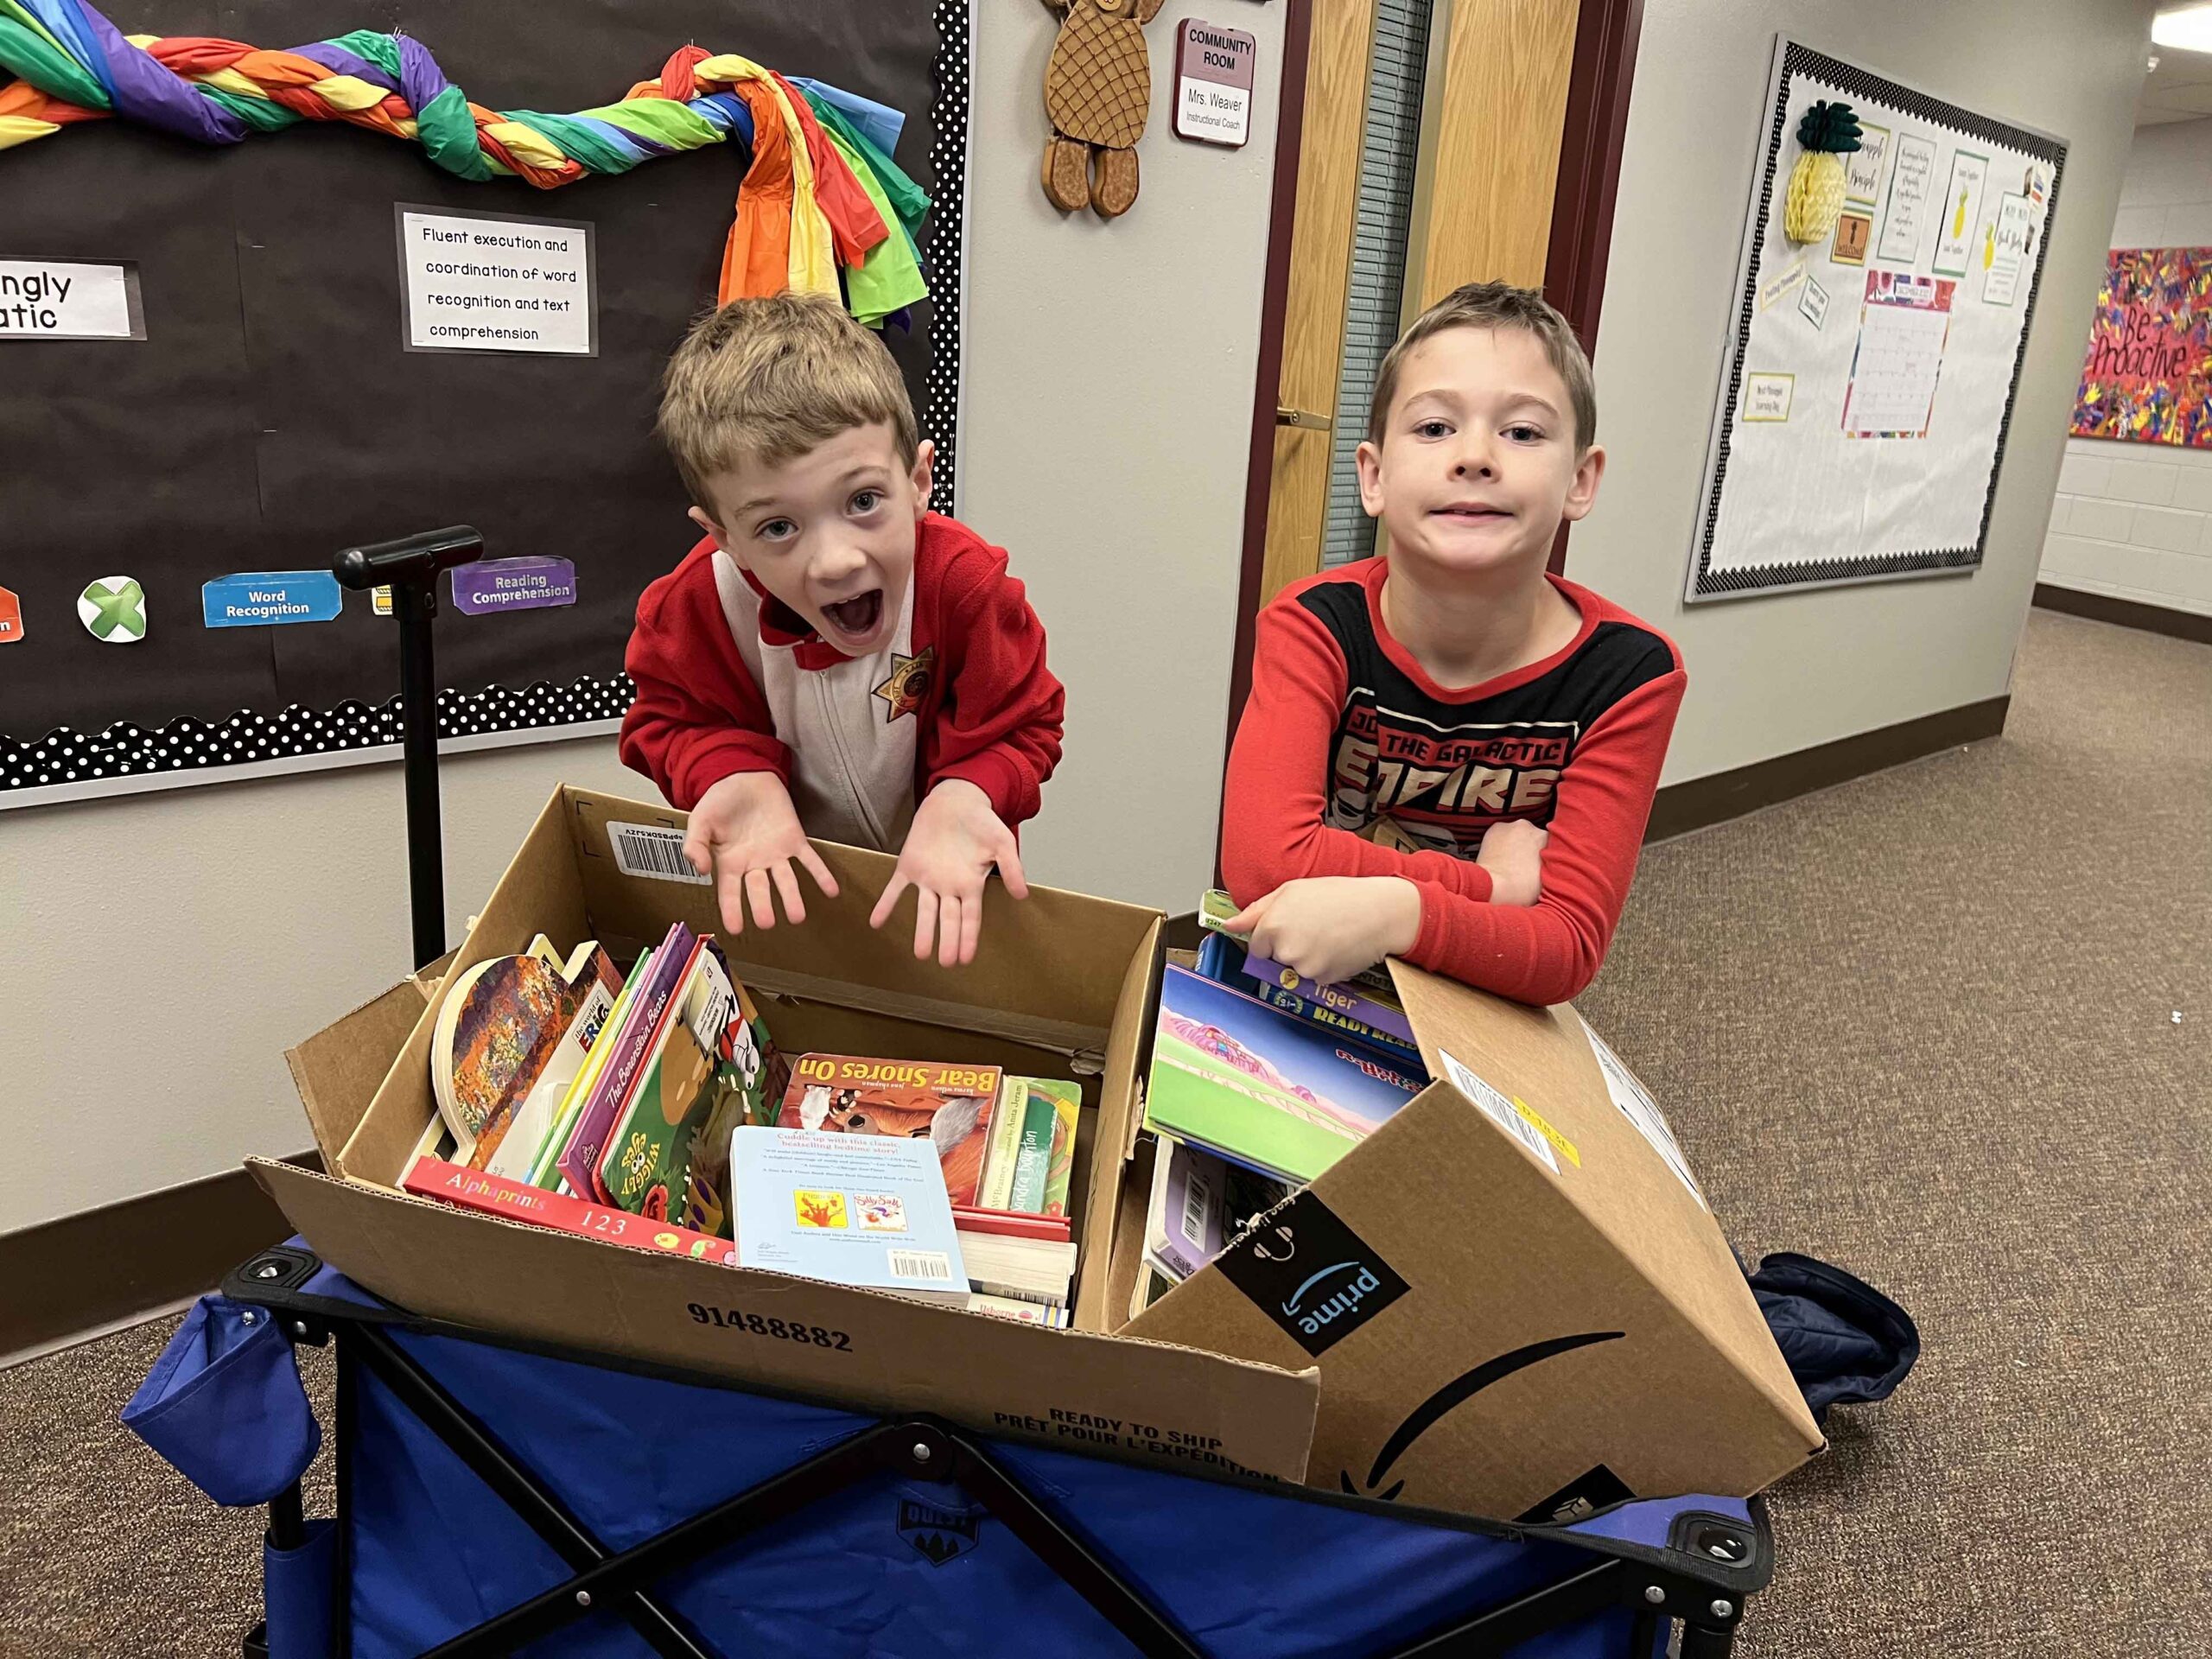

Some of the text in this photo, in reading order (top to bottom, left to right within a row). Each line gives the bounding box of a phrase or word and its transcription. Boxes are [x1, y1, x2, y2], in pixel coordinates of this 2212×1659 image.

[1190, 29, 1252, 54] COMMUNITY
[1204, 52, 1236, 69] ROOM
[1188, 88, 1243, 111] Mrs. Weaver
[1186, 111, 1240, 130] Instructional Coach
[423, 228, 568, 252] Fluent execution and
[426, 262, 576, 283] coordination of word
[2, 271, 71, 303] ngly
[428, 294, 570, 311] recognition and text
[429, 325, 538, 340] comprehension
[2124, 306, 2151, 346] Be
[2093, 333, 2187, 379] Proactive
[472, 586, 570, 604] Comprehension
[496, 575, 547, 589] Reading
[249, 590, 286, 602] Word
[226, 603, 309, 618] Recognition
[1385, 734, 1562, 763] THE GALACTIC
[1315, 983, 1357, 1010] Tiger
[575, 995, 601, 1039] the world of
[1313, 1006, 1370, 1035] READY
[605, 1084, 623, 1109] The
[647, 990, 667, 1027] Bears
[799, 1058, 996, 1092] Bear Snores On
[1008, 1107, 1018, 1131] Anita
[778, 1133, 810, 1141] Cuddle
[827, 1135, 848, 1144] with
[621, 1142, 660, 1195] WIGGLY
[446, 1172, 547, 1211] Alphaprints
[1298, 1266, 1380, 1334] prime
[687, 1302, 854, 1353] 91488882
[995, 1411, 1049, 1433] PRÊT
[1058, 1425, 1118, 1446] POUR
[1049, 1408, 1223, 1451] READY TO SHIP
